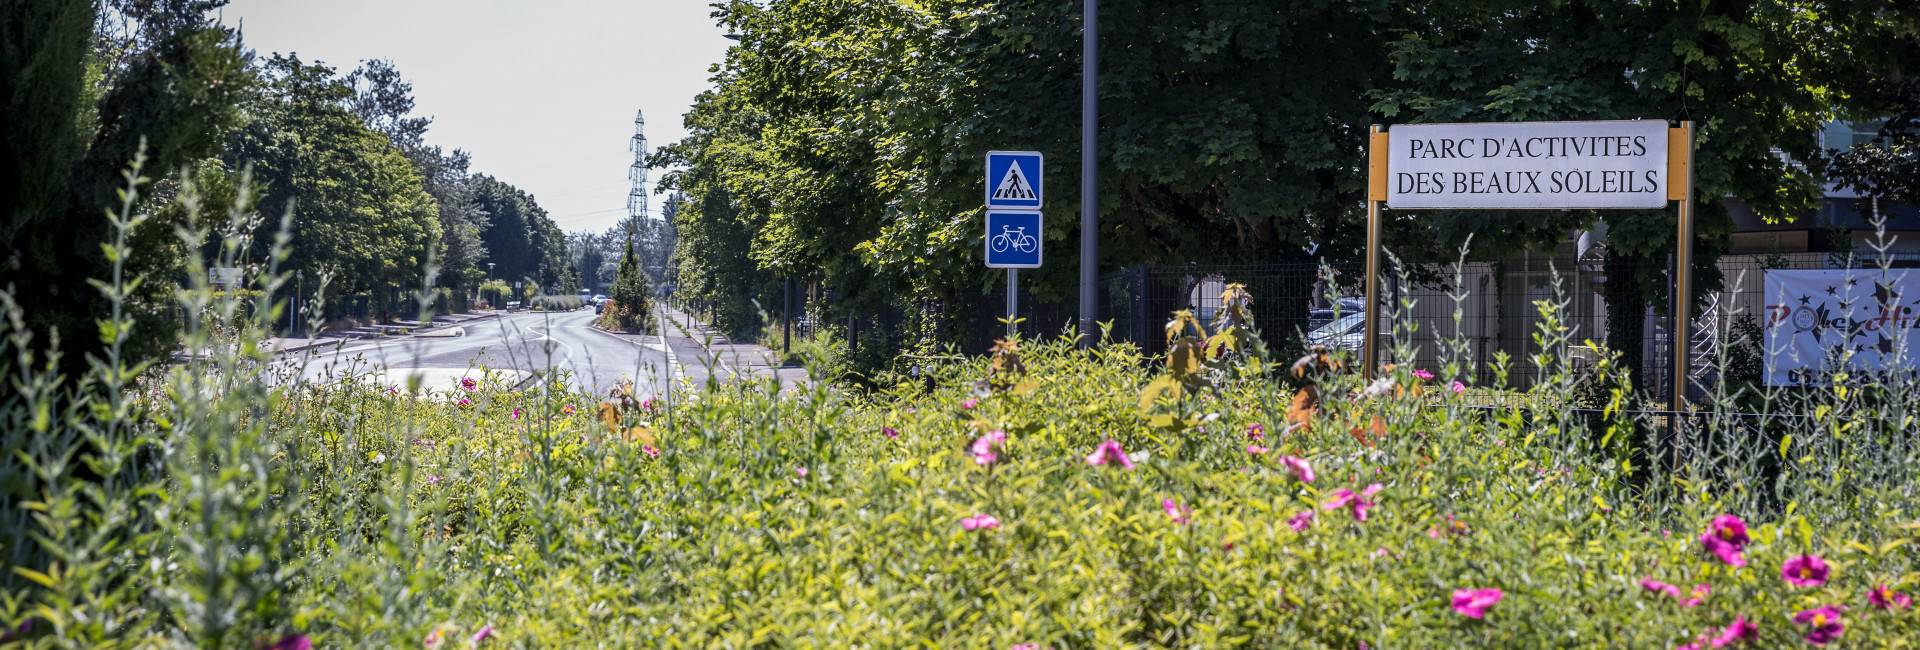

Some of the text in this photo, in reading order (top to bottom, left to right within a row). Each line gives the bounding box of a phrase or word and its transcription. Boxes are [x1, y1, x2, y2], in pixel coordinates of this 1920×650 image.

[1409, 135, 1647, 159] PARC D'ACTIVITES
[1397, 170, 1658, 195] DES BEAUX SOLEILS
